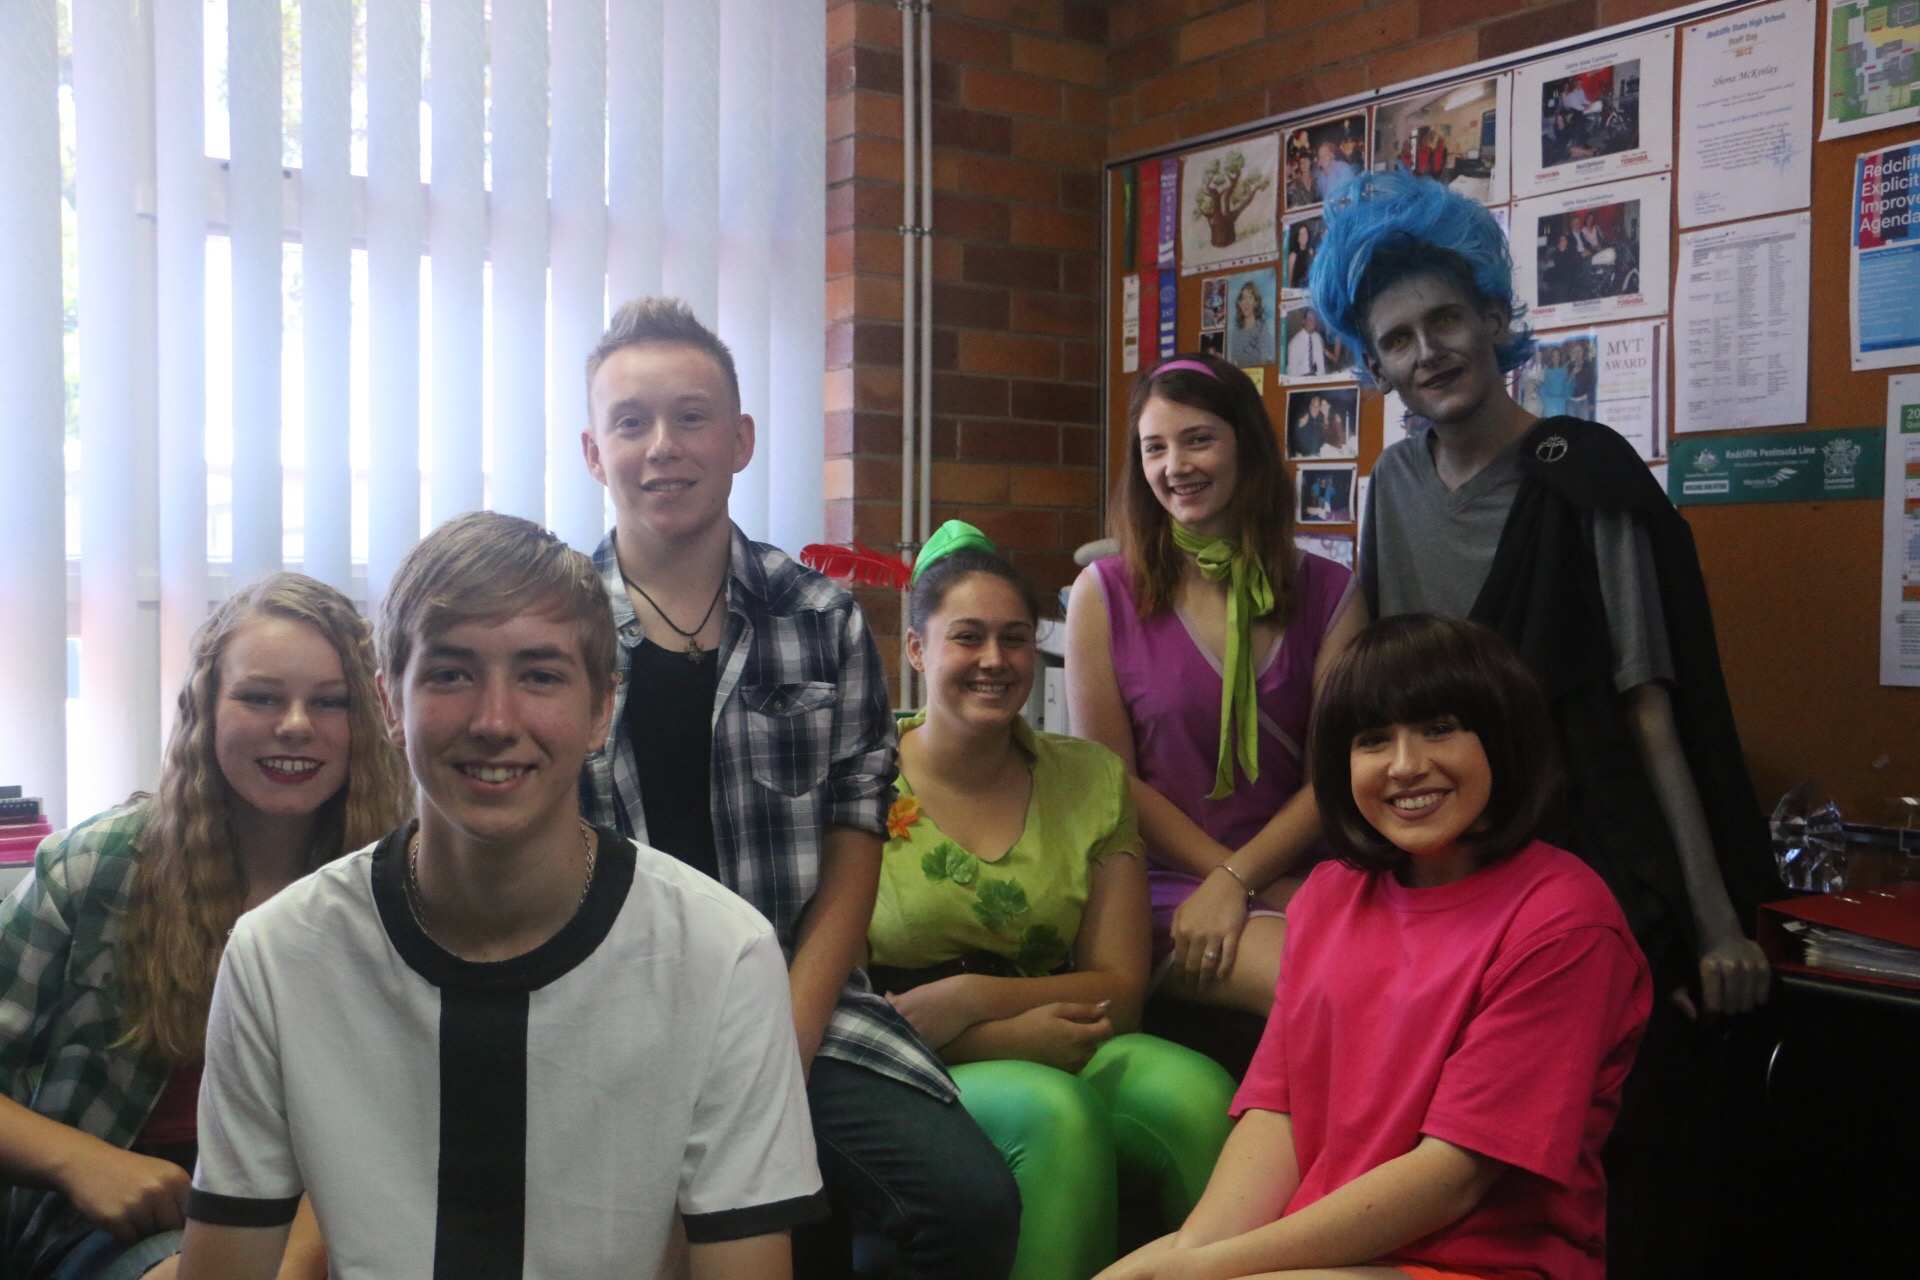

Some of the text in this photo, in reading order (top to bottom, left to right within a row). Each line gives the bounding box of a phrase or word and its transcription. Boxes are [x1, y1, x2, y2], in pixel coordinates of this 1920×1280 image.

[1861, 173, 1920, 196] Explicit
[1859, 209, 1920, 235] Agenda
[1607, 337, 1645, 356] MVT
[1605, 357, 1647, 371] AWARD
[1725, 445, 1816, 459] Redcliffe Peninsula Line
